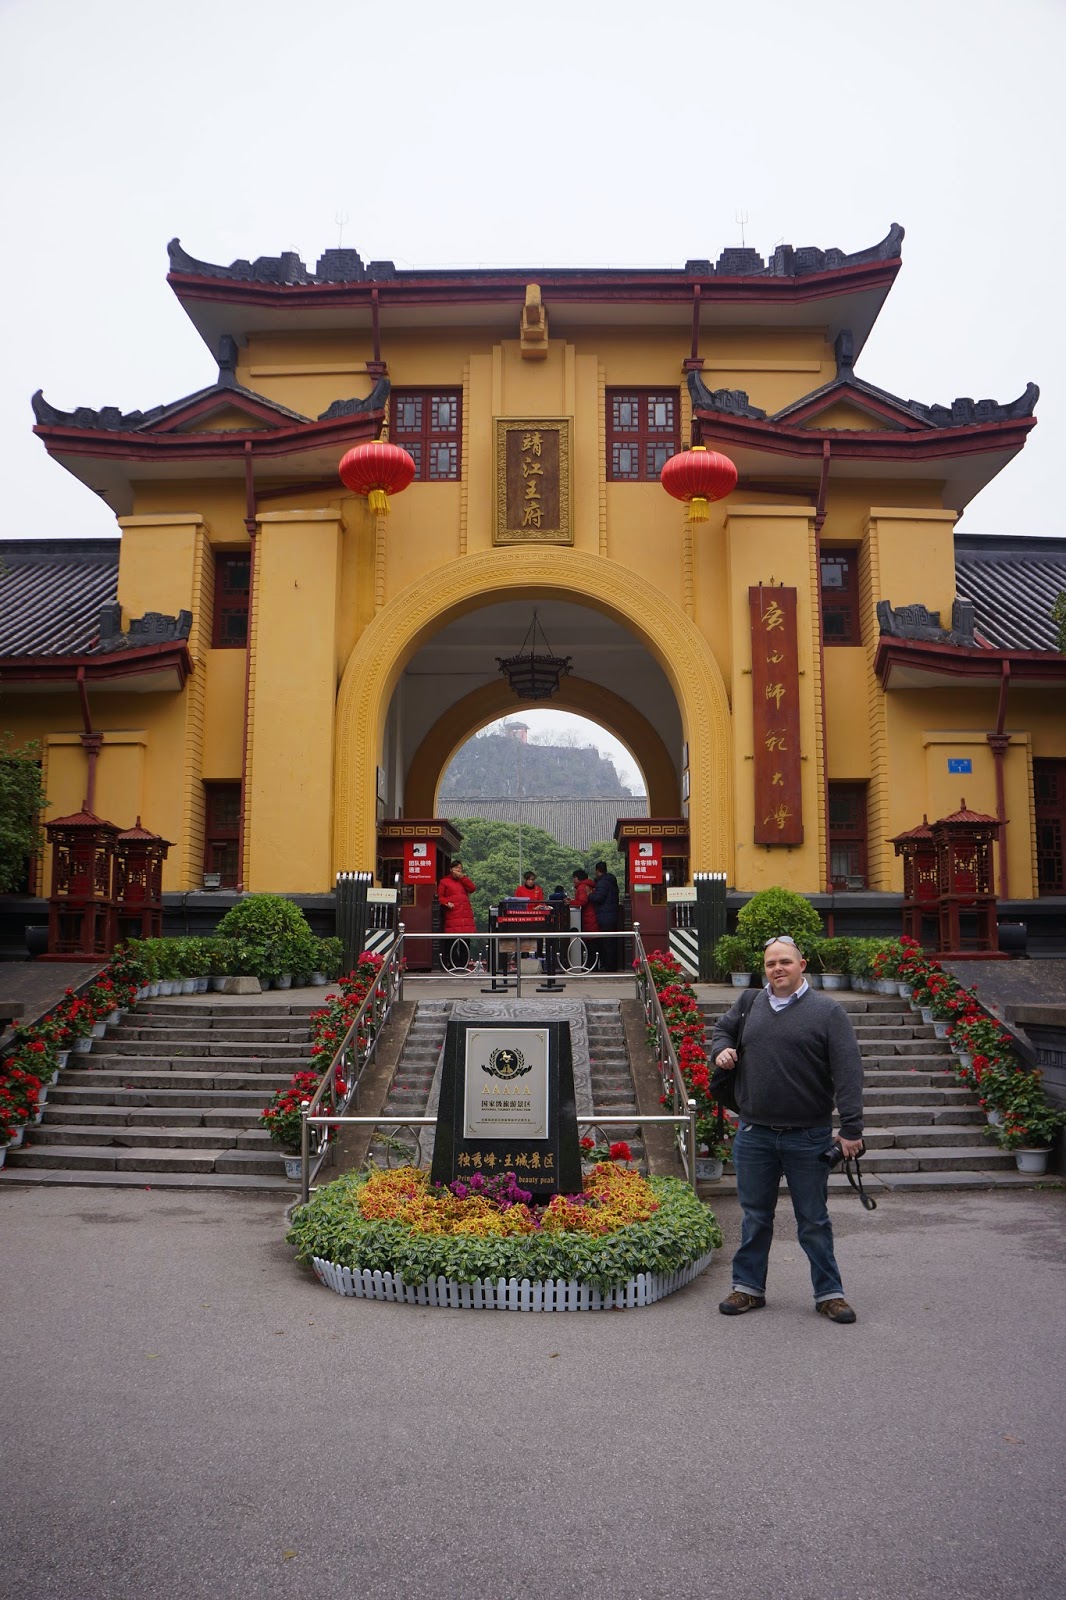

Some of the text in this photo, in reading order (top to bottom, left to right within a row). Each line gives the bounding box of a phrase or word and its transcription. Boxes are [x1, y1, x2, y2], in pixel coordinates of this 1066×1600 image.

[520, 431, 545, 529] 靖江王府
[518, 1175, 538, 1185] beauty
[540, 1176, 555, 1185] peak
